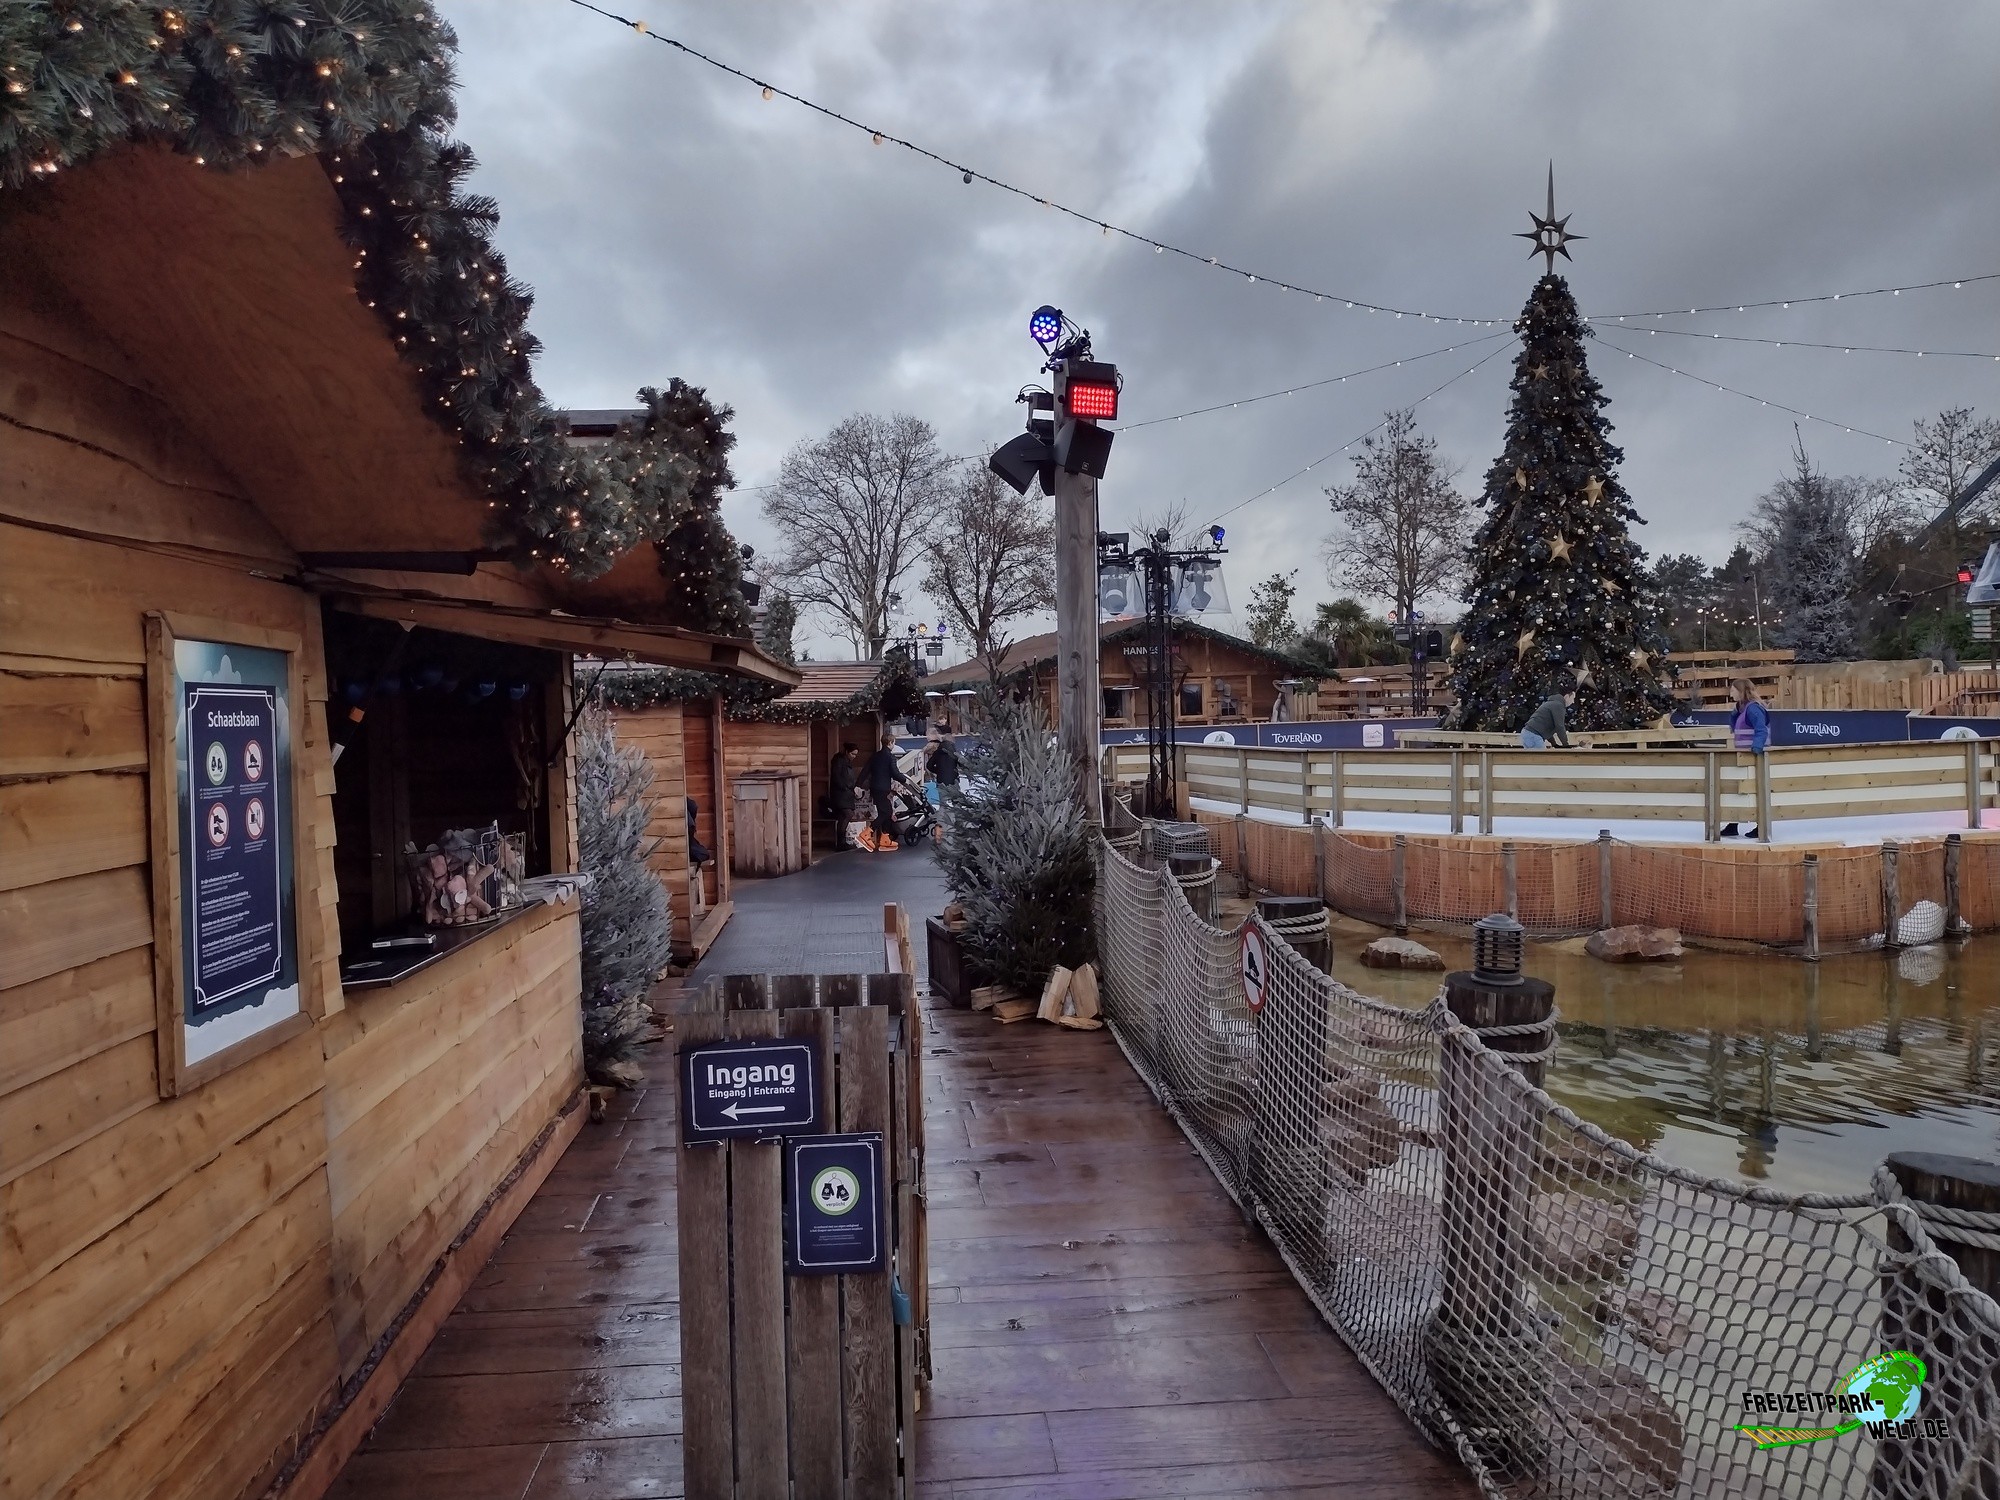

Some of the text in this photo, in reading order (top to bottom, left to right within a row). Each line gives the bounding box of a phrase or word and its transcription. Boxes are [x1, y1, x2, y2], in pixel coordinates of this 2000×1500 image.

[208, 710, 260, 727] Schaatsbaan
[707, 1064, 795, 1088] Ingang
[708, 1089, 746, 1099] Eingang
[753, 1086, 796, 1096] Entrance
